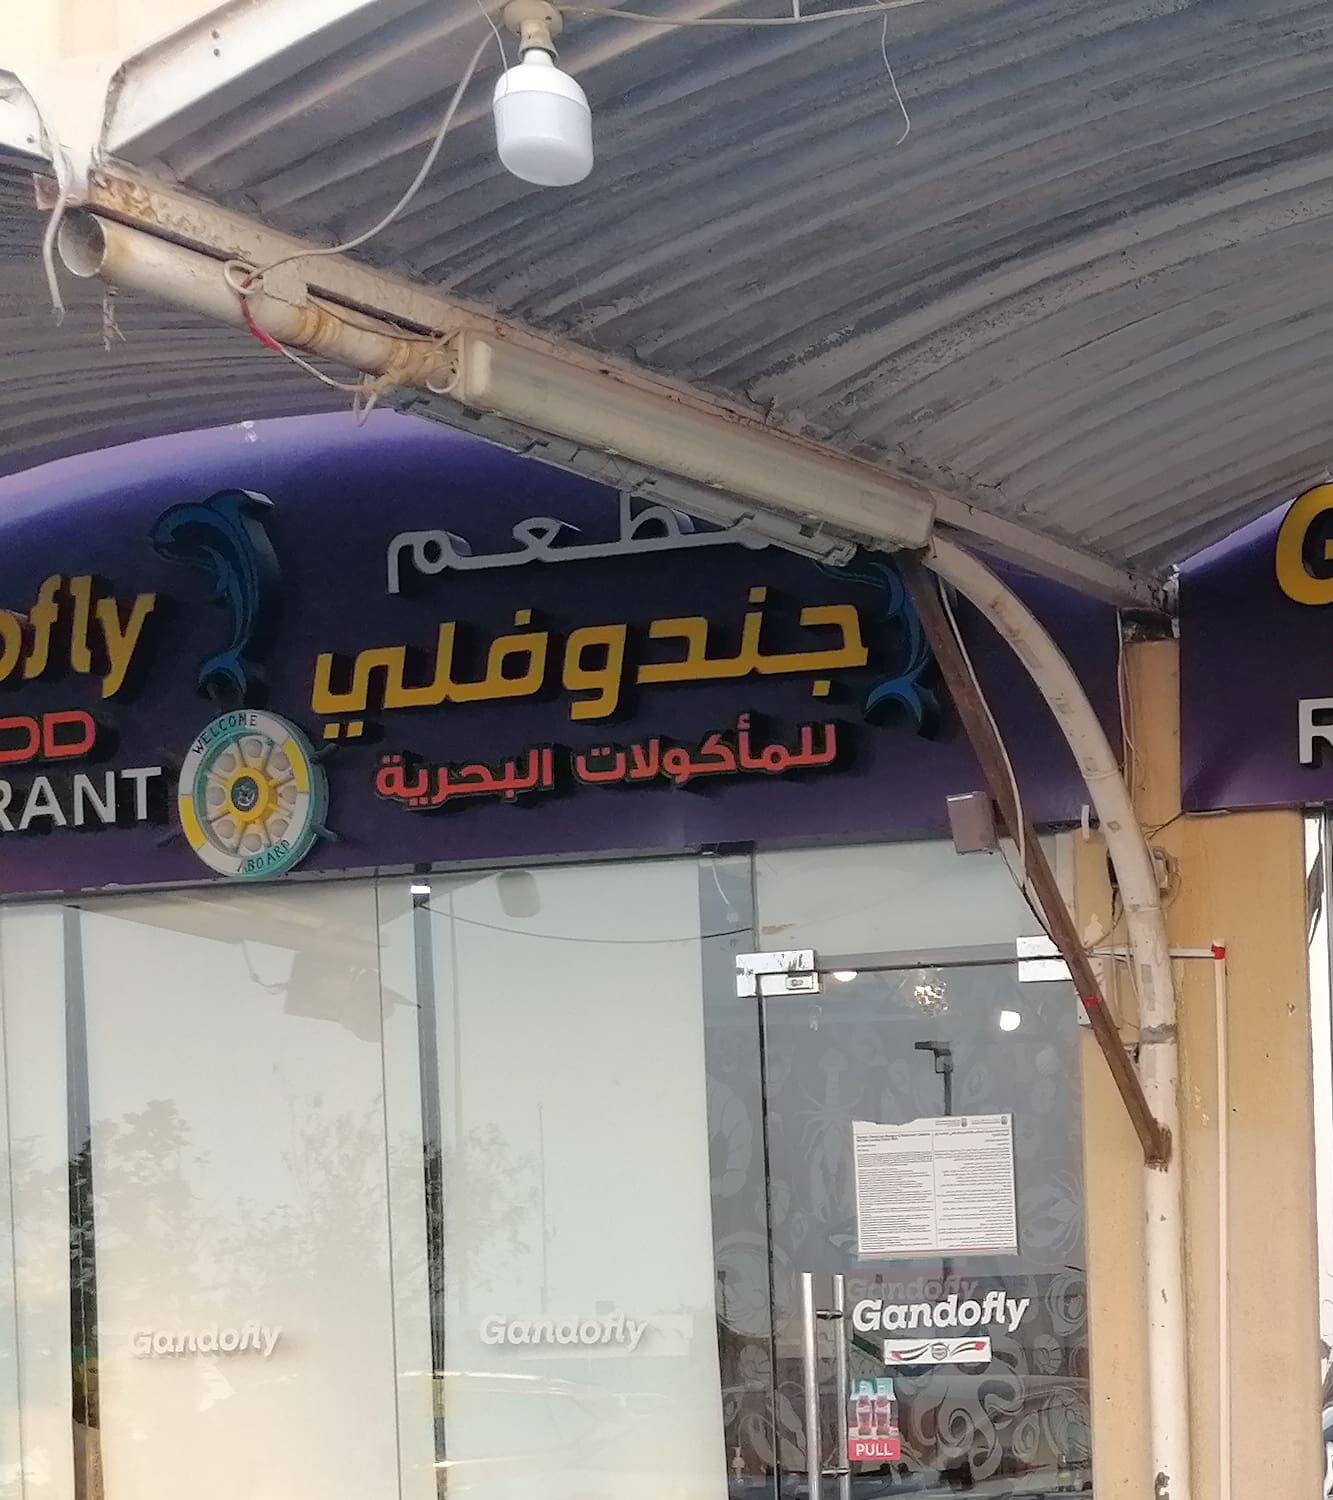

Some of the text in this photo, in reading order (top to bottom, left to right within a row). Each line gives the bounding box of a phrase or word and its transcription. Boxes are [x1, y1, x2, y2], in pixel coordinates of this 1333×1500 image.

[387, 492, 775, 594] طعم
[311, 587, 869, 740] جندوفلي
[192, 713, 258, 755] WELCOME
[375, 714, 837, 808] للمأكولات البحرية
[479, 1314, 648, 1352] Gandofly
[852, 1291, 1030, 1333] Gandofly
[127, 1319, 282, 1357] Gandofly
[855, 1442, 895, 1457] PULL
